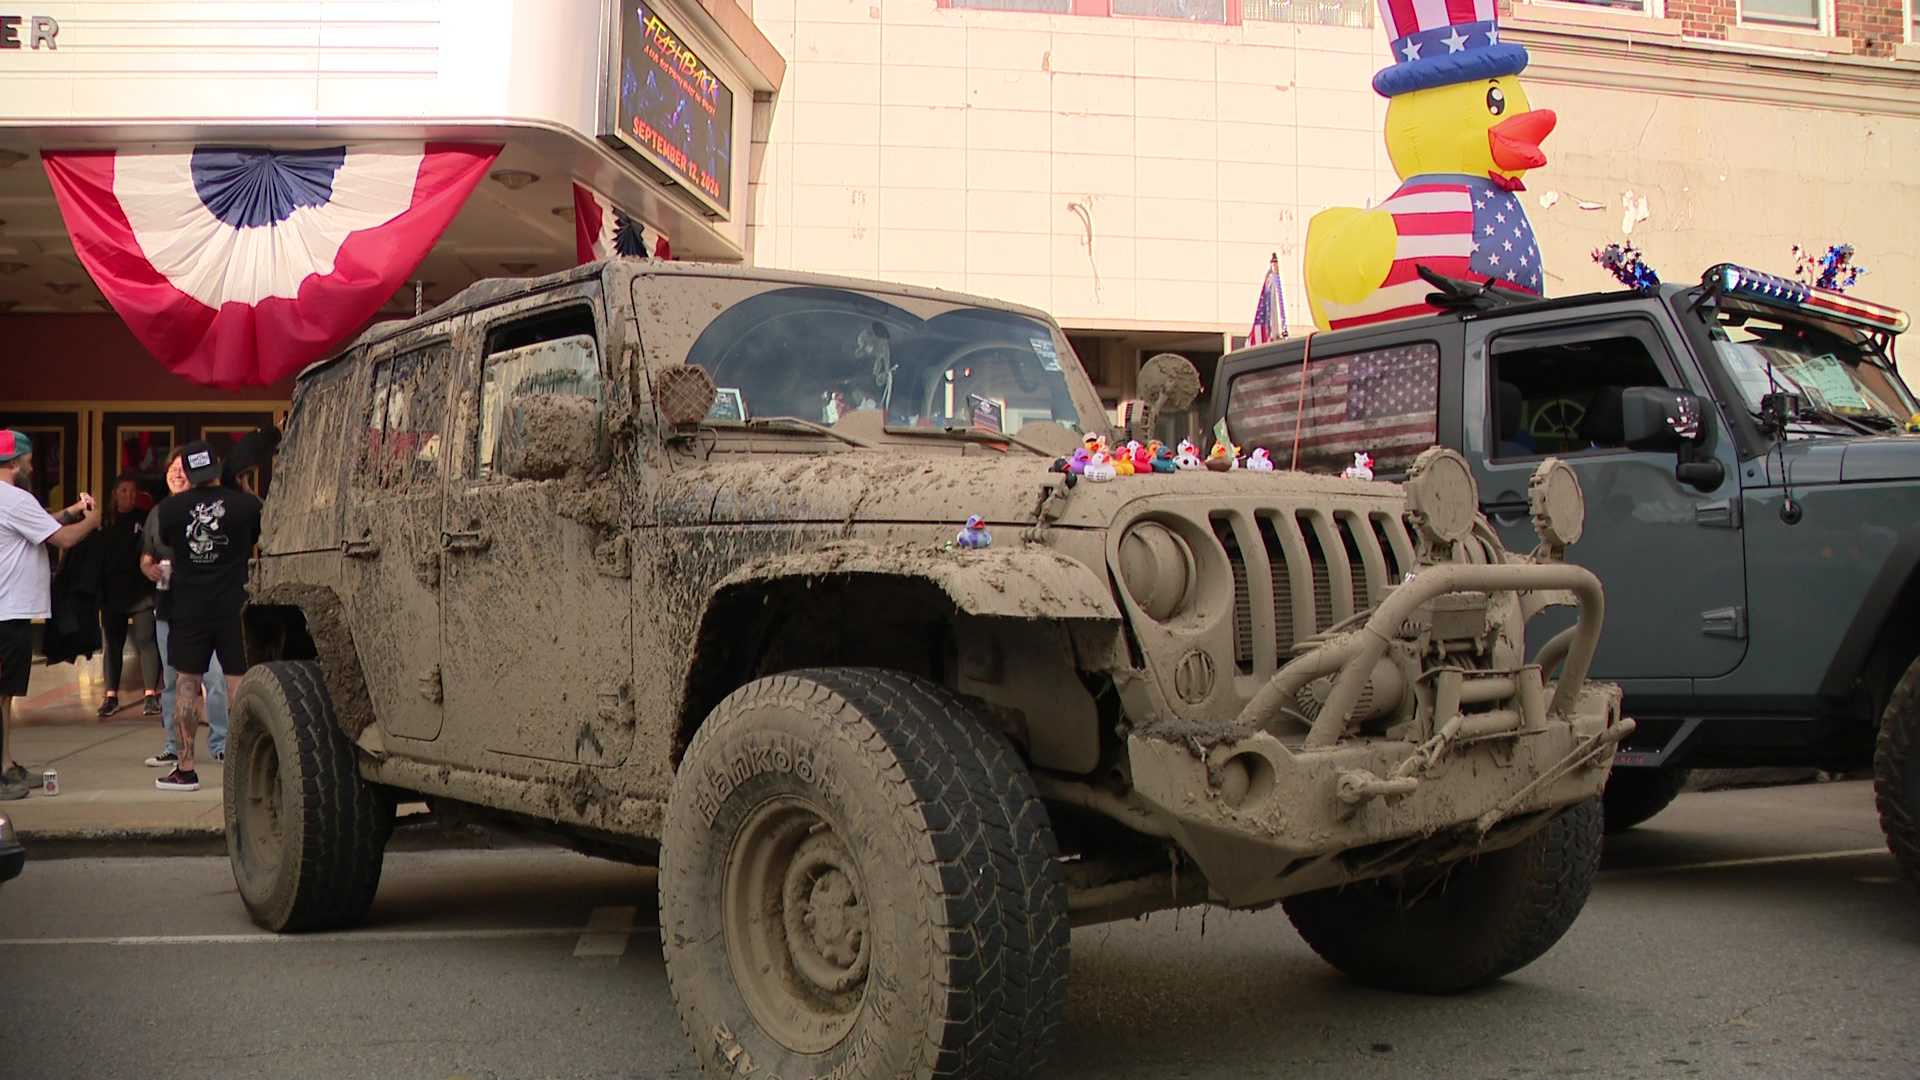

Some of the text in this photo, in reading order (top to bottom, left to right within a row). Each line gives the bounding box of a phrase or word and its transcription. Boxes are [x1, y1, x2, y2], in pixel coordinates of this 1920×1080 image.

[0, 15, 59, 50] ER
[632, 116, 689, 173] SEPTEMBER
[688, 160, 700, 184] 12,
